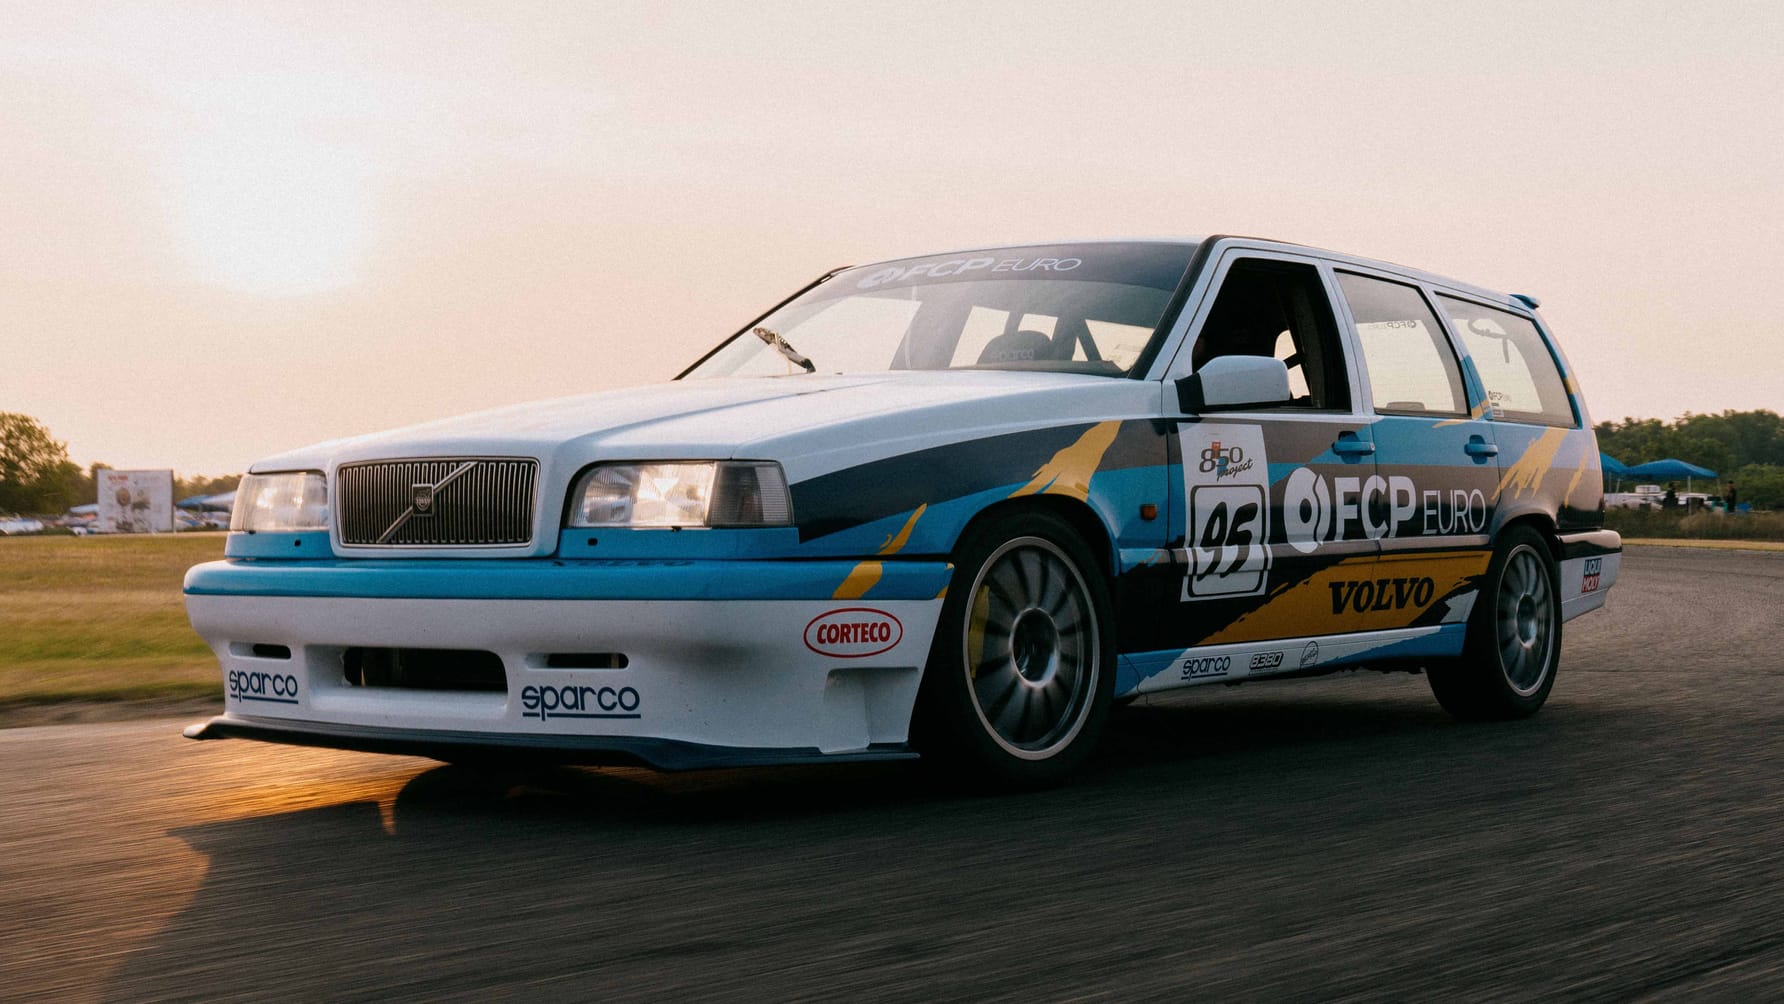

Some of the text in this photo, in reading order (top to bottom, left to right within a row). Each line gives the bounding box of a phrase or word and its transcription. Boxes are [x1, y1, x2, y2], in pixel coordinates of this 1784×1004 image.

[897, 257, 1082, 281] FCP EURO
[1199, 446, 1244, 474] 850
[1216, 457, 1254, 483] project
[1334, 474, 1487, 542] FCP EURO
[1196, 501, 1259, 582] 95
[1328, 576, 1435, 615] VOLVO
[816, 621, 891, 645] CORTECO
[1182, 655, 1231, 681] sparco
[229, 669, 299, 704] sparco
[521, 685, 641, 721] sparco
